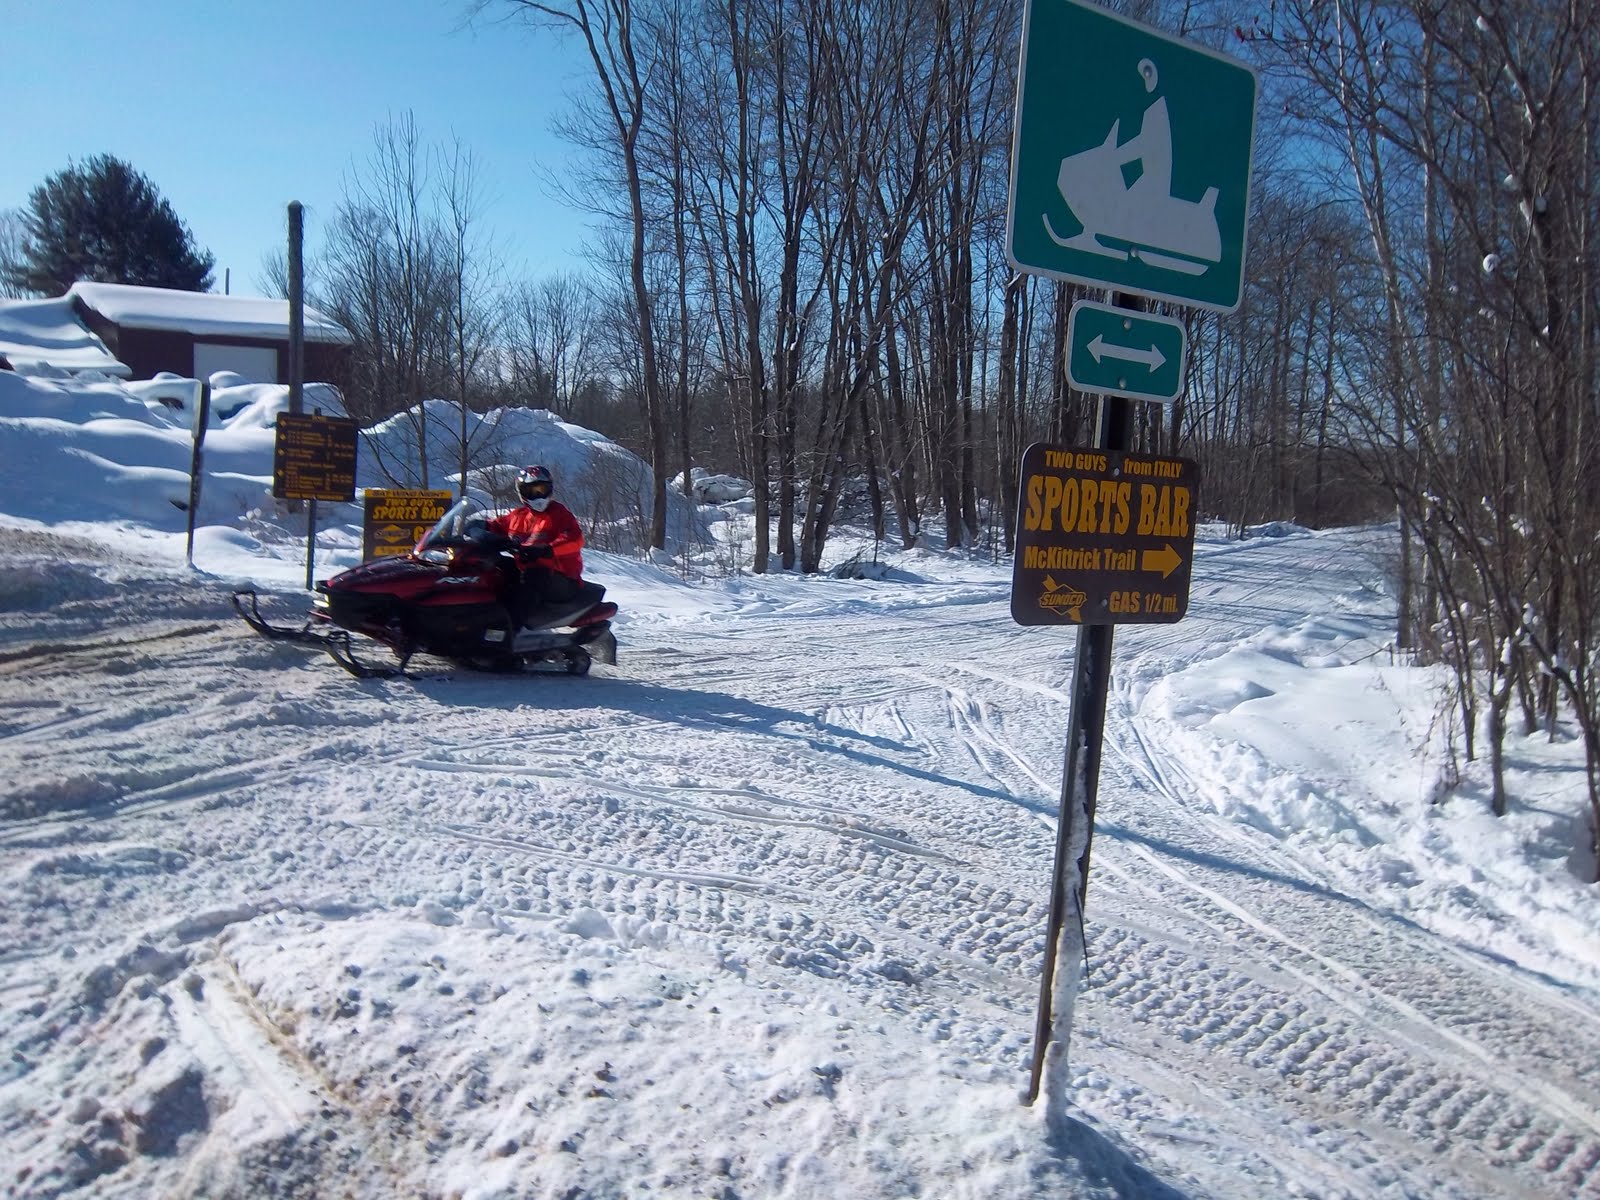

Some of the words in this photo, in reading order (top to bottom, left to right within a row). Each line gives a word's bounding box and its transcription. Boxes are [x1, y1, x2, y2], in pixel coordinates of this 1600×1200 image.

[1045, 450, 1073, 468] TWO
[1076, 453, 1107, 472] GUYS
[1124, 458, 1153, 475] from
[1153, 460, 1183, 478] ITALY
[373, 506, 418, 520] SPORTS
[421, 507, 445, 520] BAR
[385, 499, 406, 507] TWO
[410, 499, 435, 507] GUYS
[1024, 475, 1132, 535] SPORTS
[1137, 484, 1191, 538] BAR
[1024, 546, 1101, 570] McKittrick
[1104, 548, 1137, 571] Trail
[1041, 593, 1084, 606] SUNOCO
[1109, 591, 1140, 613] GAS
[1145, 593, 1162, 613] 1/2
